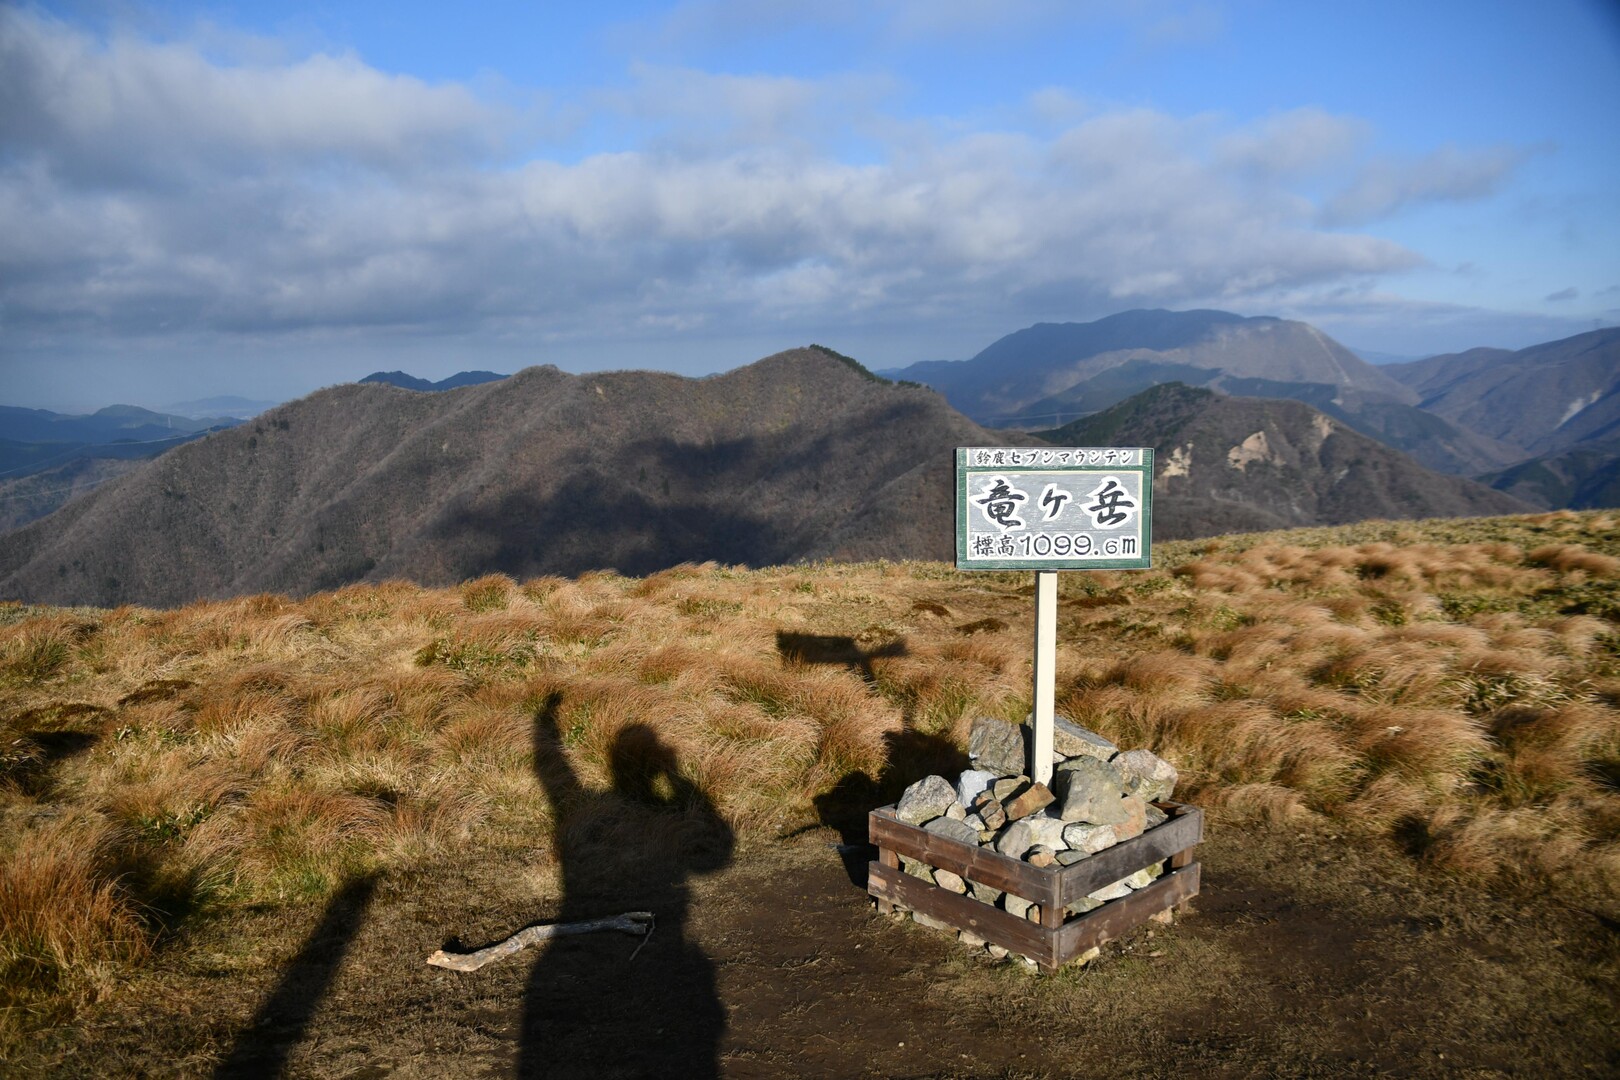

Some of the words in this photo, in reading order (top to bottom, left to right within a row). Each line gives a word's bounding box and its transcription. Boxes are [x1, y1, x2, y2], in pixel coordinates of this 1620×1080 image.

[976, 450, 1133, 465] 鈴鹿セブンマウンテン
